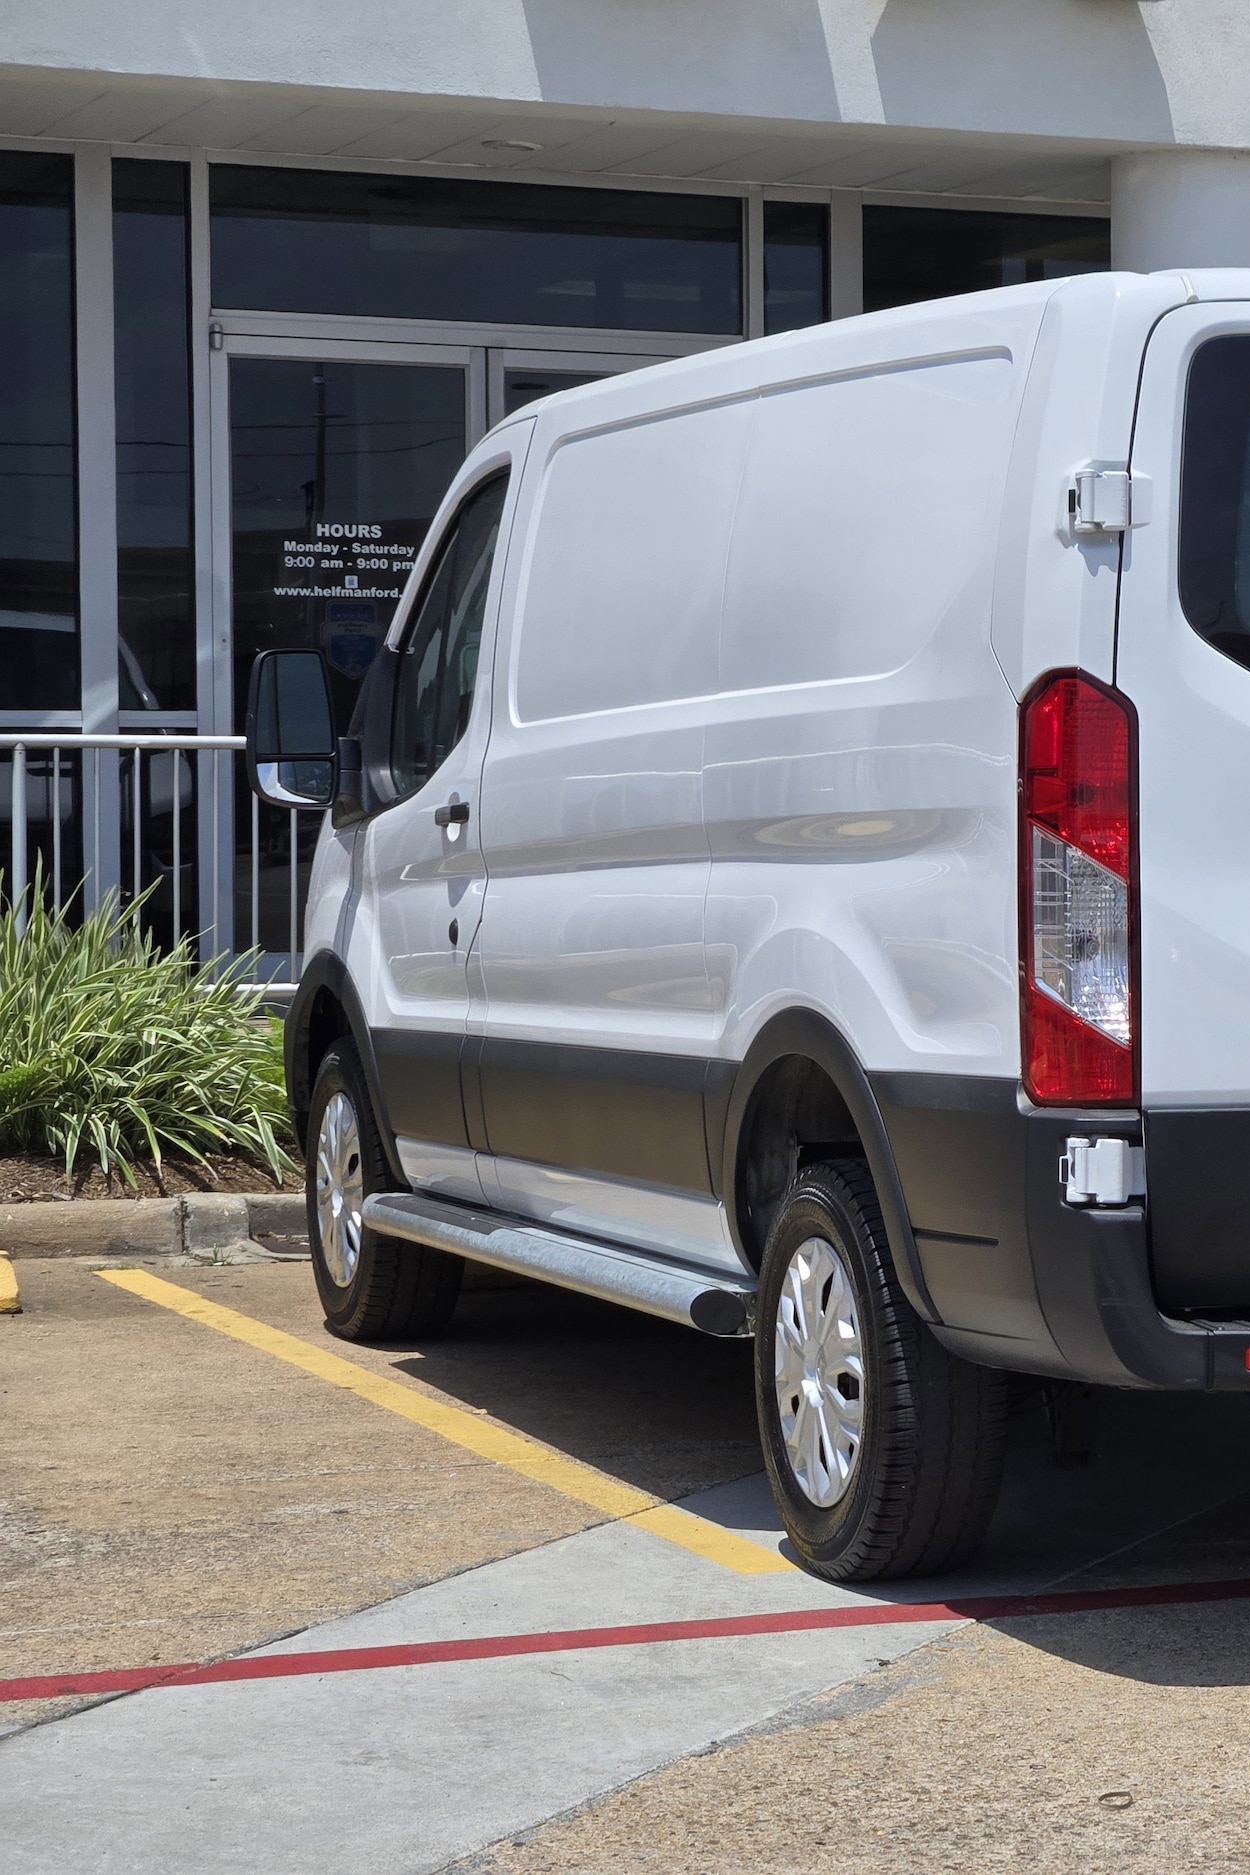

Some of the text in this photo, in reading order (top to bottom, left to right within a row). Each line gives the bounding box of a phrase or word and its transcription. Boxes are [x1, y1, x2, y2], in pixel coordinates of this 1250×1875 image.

[316, 523, 383, 539] HOURS
[283, 541, 340, 556] Monday
[351, 542, 416, 557] Saturday
[284, 556, 315, 568] 9:00
[320, 559, 344, 569] am
[356, 558, 389, 570] 9:00
[392, 560, 416, 573] pm
[273, 586, 403, 599] www.helfmanford.
